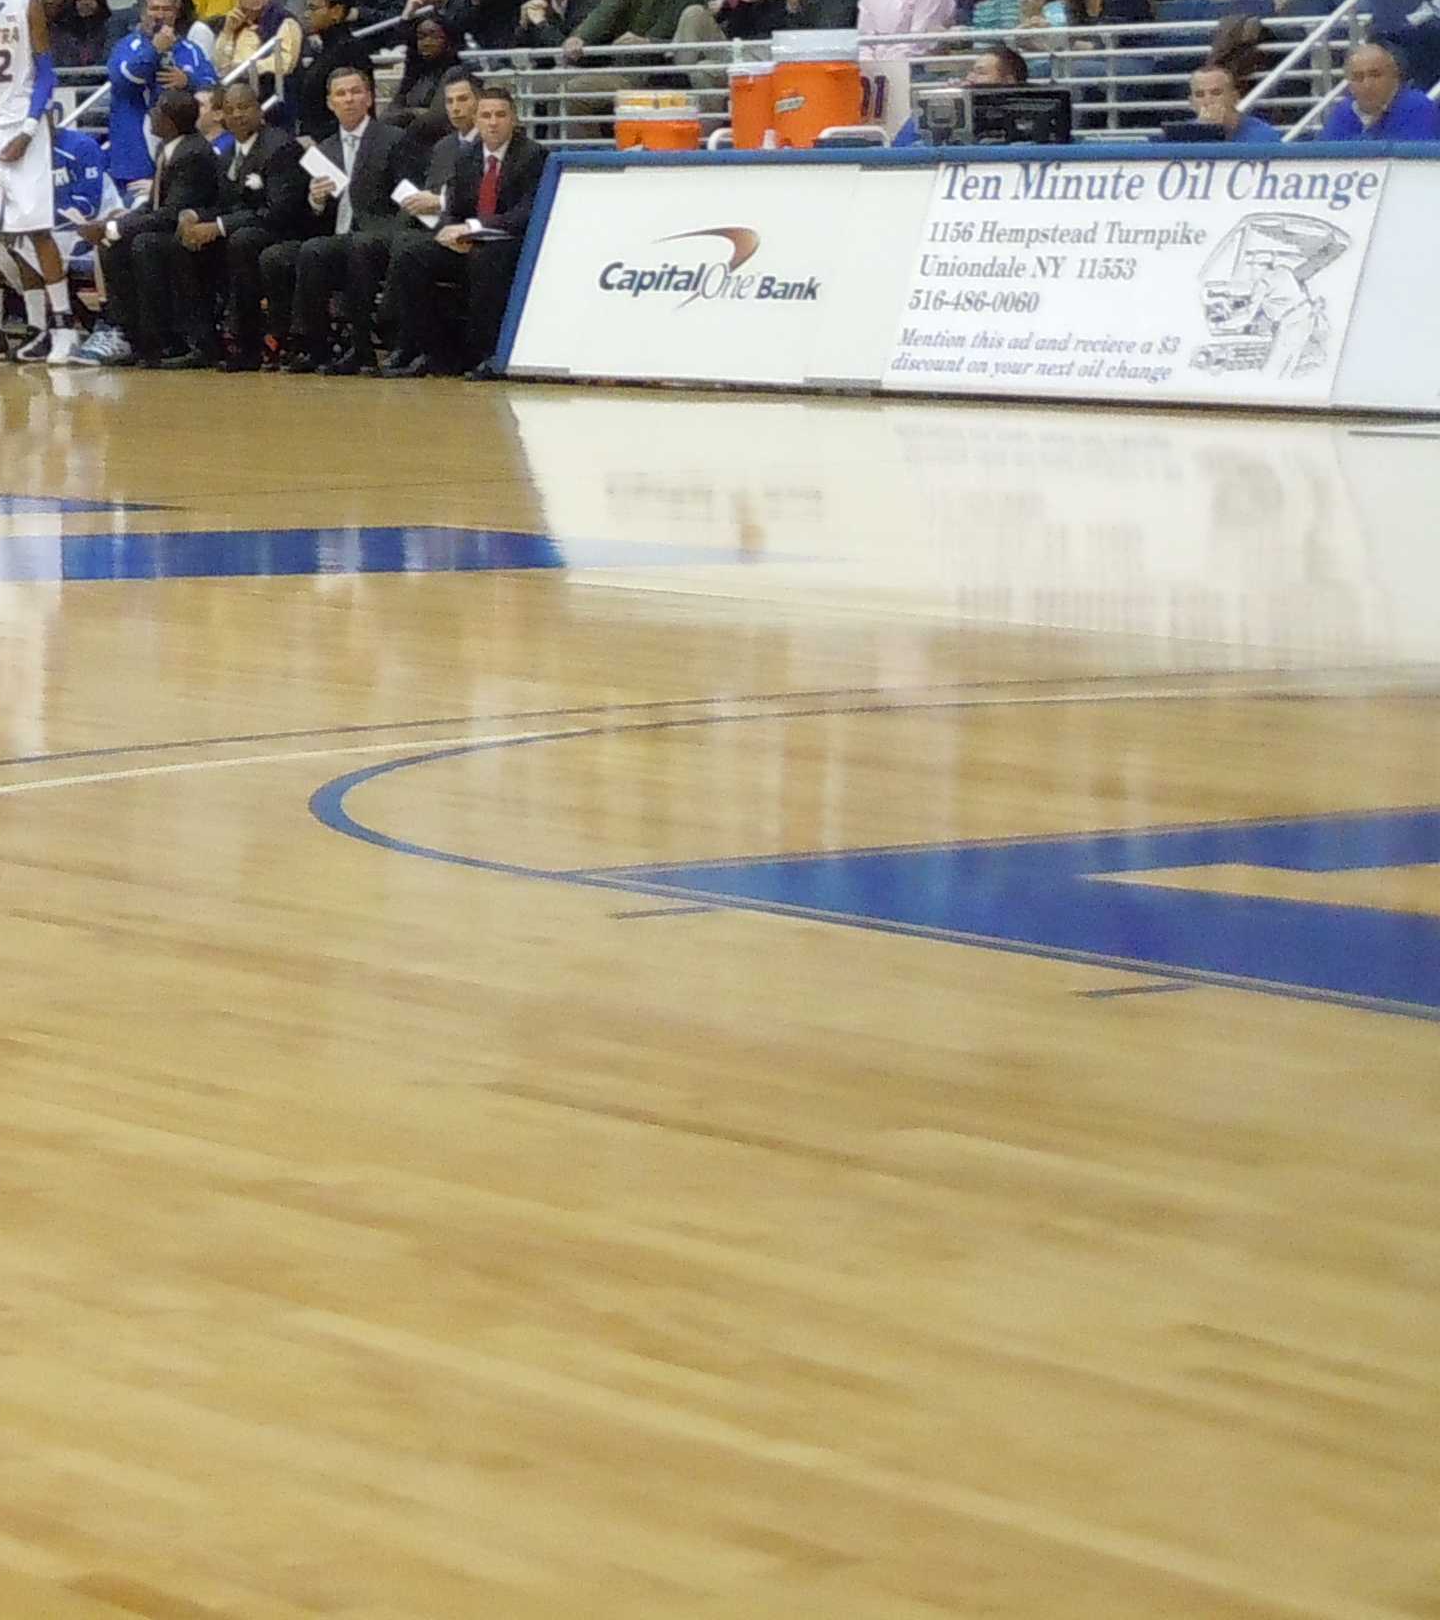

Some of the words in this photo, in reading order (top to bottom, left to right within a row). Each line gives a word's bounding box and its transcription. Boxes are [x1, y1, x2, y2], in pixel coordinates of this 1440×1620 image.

[941, 163, 1002, 200] Ten
[1010, 162, 1145, 200] Minute
[1157, 161, 1216, 201] Oil
[1227, 161, 1379, 211] Change
[928, 221, 975, 243] 1156
[977, 220, 1097, 249] Hempstead
[1106, 220, 1207, 250] Turnpike
[920, 254, 1026, 278] Uniondale
[1031, 256, 1066, 279] NY
[1077, 257, 1138, 280] 11553
[755, 275, 822, 301] Bank
[908, 290, 1040, 313] 516-486-0060
[898, 328, 966, 349] Mention
[970, 330, 1003, 350] this
[1007, 332, 1031, 351] ad
[1035, 333, 1068, 352] and
[1140, 341, 1154, 355] a
[1157, 335, 1181, 355] $3
[891, 353, 965, 373] discount
[967, 361, 988, 374] on
[990, 361, 1030, 378] your
[1036, 358, 1075, 376] next
[1077, 359, 1104, 378] oil
[1105, 360, 1172, 384] change
